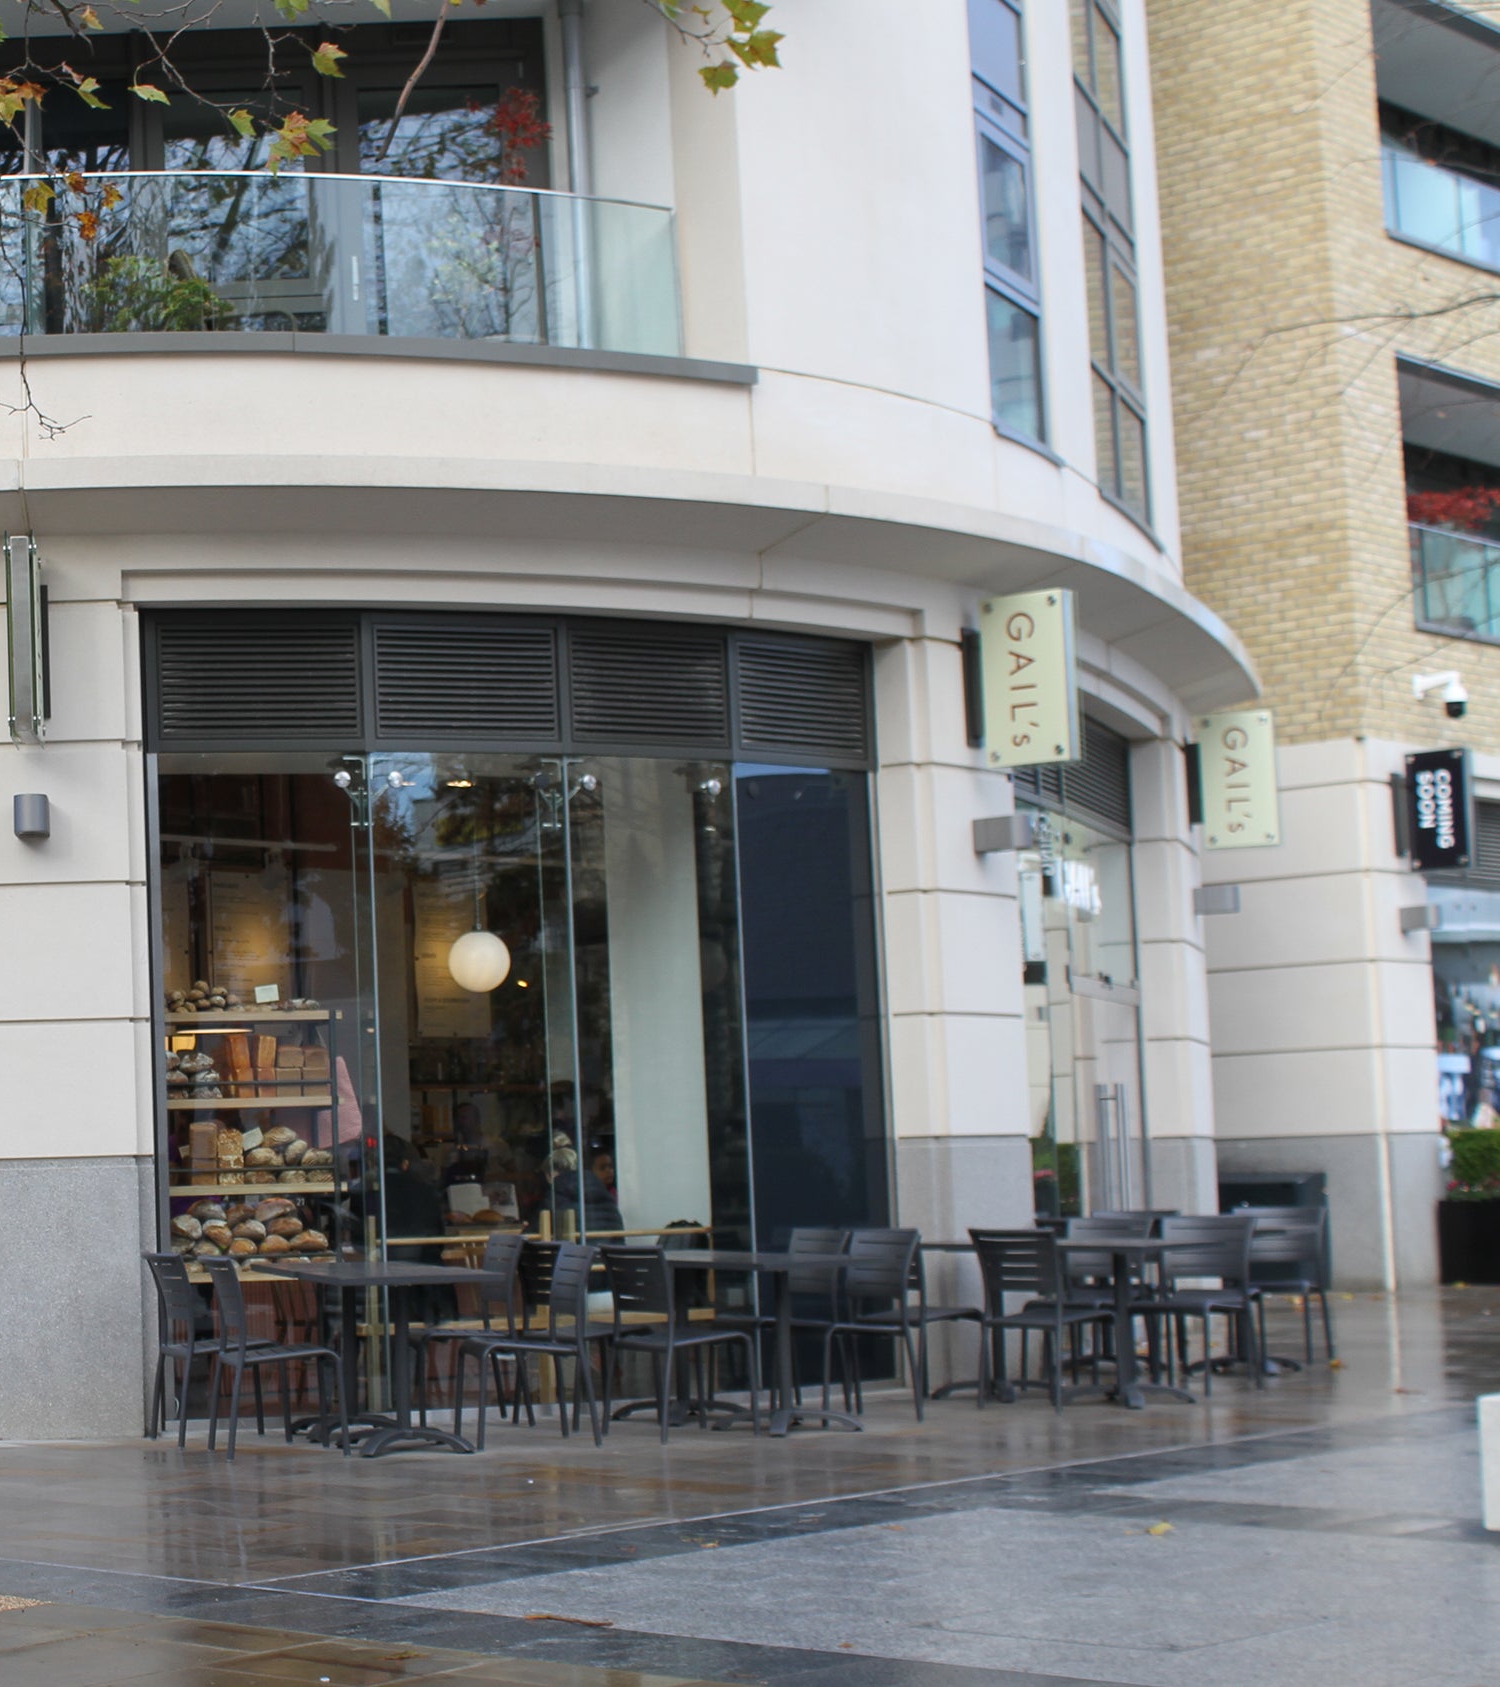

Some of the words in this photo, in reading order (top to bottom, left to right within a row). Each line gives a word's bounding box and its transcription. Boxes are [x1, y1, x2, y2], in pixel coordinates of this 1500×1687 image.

[1006, 611, 1040, 748] GAIL's
[1222, 726, 1252, 833] GAIL's
[1415, 770, 1436, 829] SOON
[1433, 768, 1456, 849] COMING
